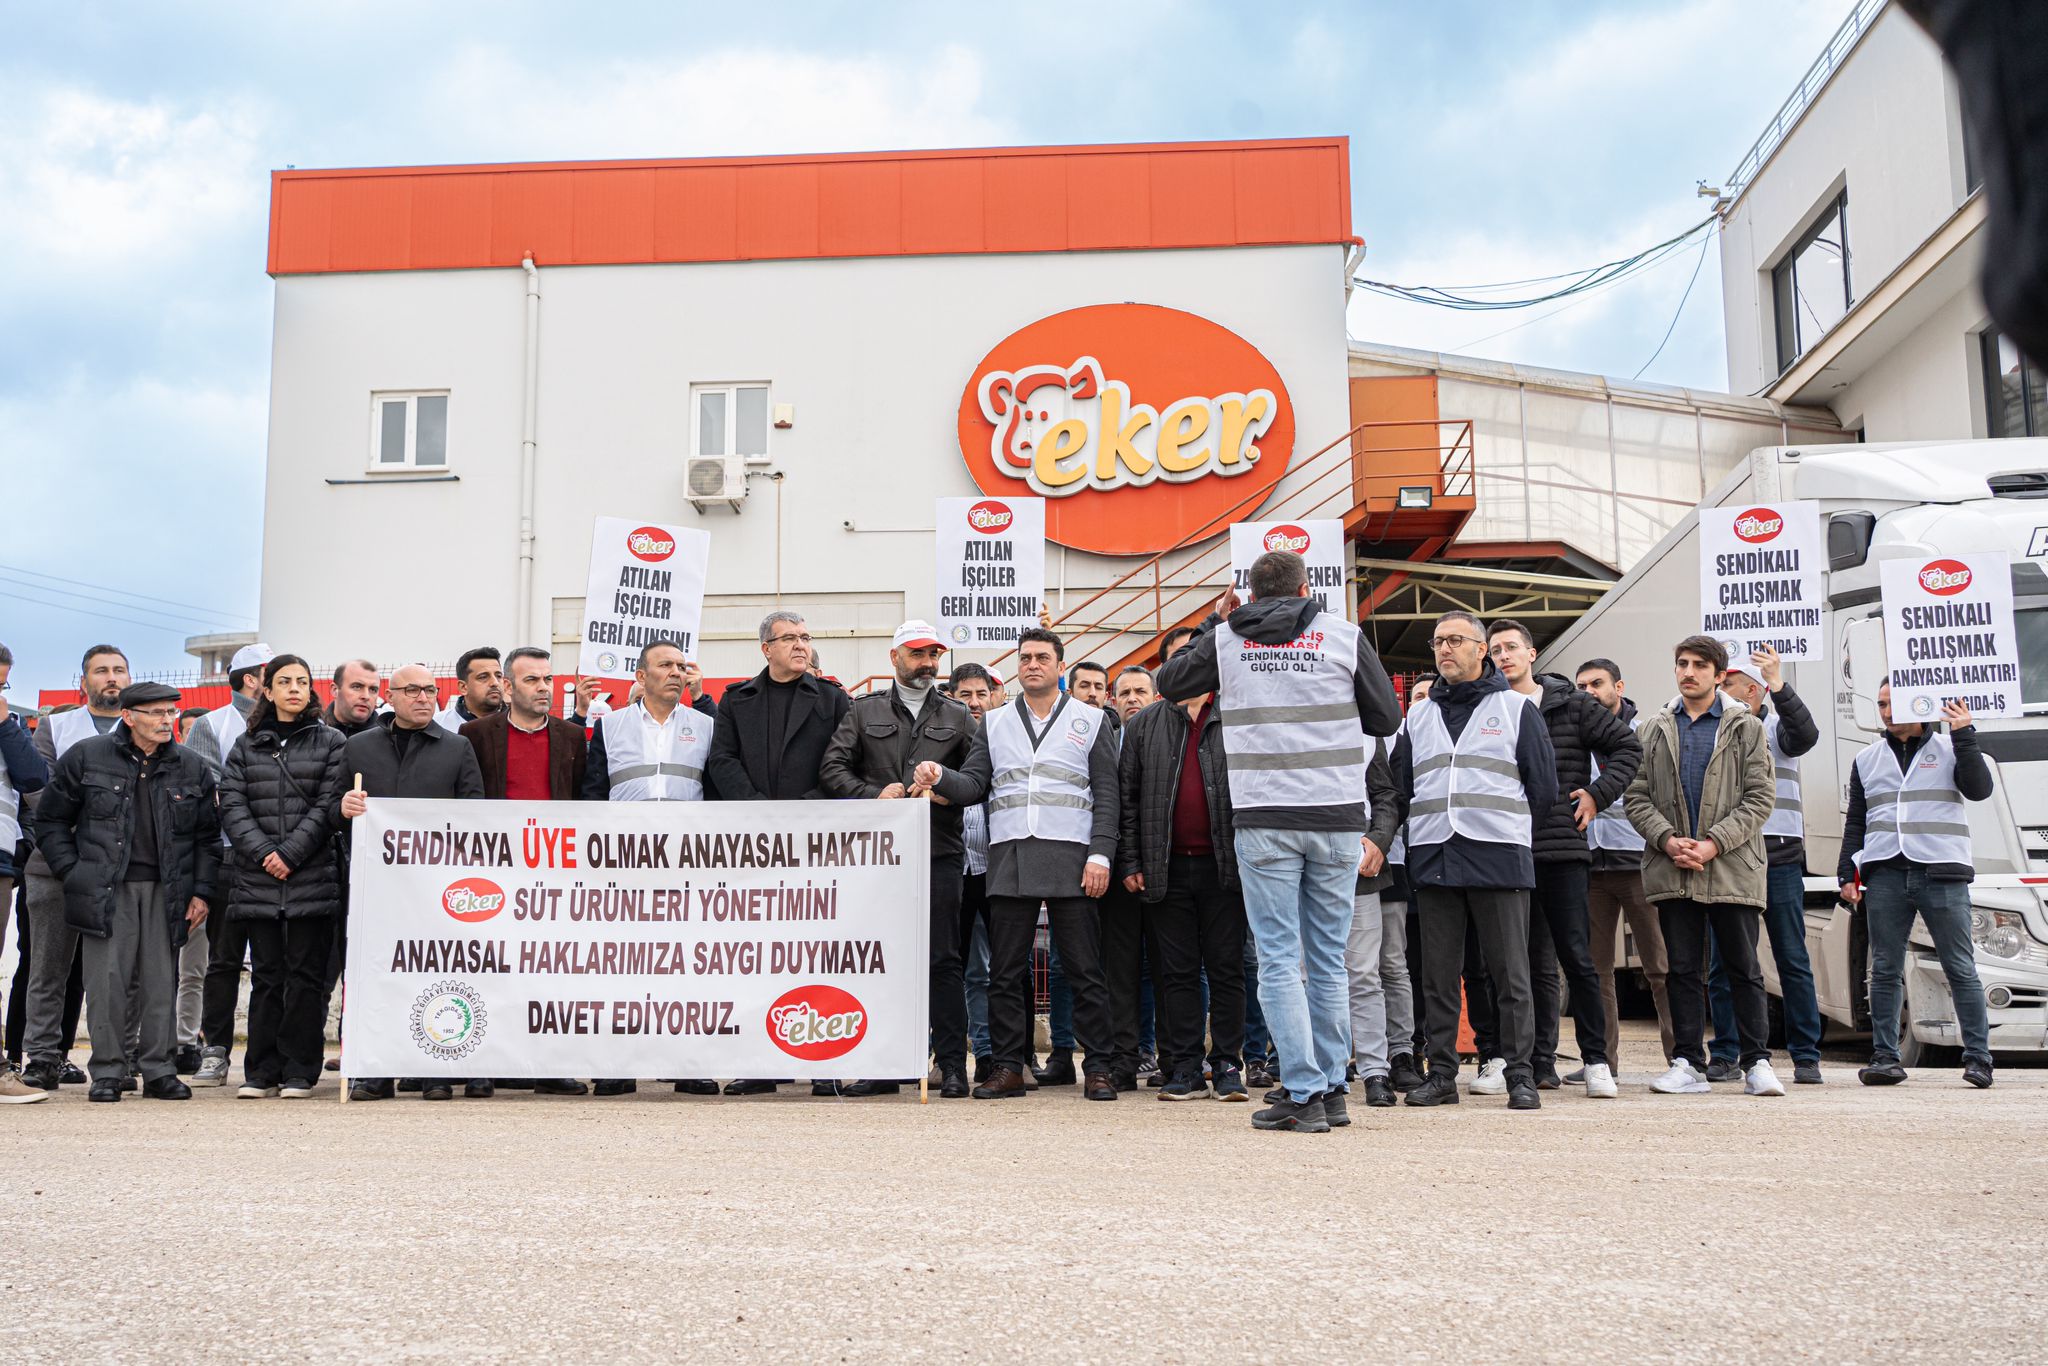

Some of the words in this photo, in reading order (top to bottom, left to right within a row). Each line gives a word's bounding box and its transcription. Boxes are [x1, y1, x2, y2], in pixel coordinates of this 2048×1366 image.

[1034, 387, 1268, 487] eker
[978, 512, 1011, 527] eker
[1744, 519, 1781, 536] eker
[637, 538, 673, 553] eker
[964, 540, 1013, 561] ATILAN
[1274, 536, 1307, 551] eker
[1716, 548, 1799, 576] SENDİKALI
[619, 566, 672, 592] ATILAN
[962, 563, 1016, 591] İŞÇİLER
[1930, 570, 1969, 589] eker
[614, 589, 672, 620] İŞÇİLER
[941, 593, 973, 617] GERİ
[976, 596, 1037, 617] ALINSIN!
[1719, 579, 1802, 610] ÇALIŞMAK
[1704, 611, 1764, 631] ANAYASAL
[1768, 608, 1819, 628] HAKTIR!
[1901, 600, 1992, 630] SENDİKALI
[588, 620, 624, 645] GERİ
[1240, 650, 1299, 661] SENDİKALI
[1303, 652, 1318, 661] OL
[1907, 633, 1997, 665] ÇALIŞMAK
[1250, 661, 1289, 674] GÜÇLÜ
[1292, 663, 1307, 672] OL
[1892, 667, 1958, 687] ANAYASAL
[1962, 663, 2017, 683] HAKTIR!
[1941, 692, 2005, 713] TGIDA-İŞ
[382, 822, 513, 868] SENDİKAYA
[522, 818, 577, 869] ÜYE
[587, 833, 670, 869] OLMAK
[678, 833, 800, 869] ANAYASAL
[807, 831, 901, 868] HAKTIR.
[455, 893, 502, 913] eker
[513, 881, 563, 921] SÜT
[569, 880, 690, 922] ÜRÜNLERİ
[698, 879, 837, 922] YÖNETİMİNİ
[391, 939, 511, 975] ANAYASAL
[519, 940, 686, 975] HAKLARIMIZA
[693, 941, 762, 975] SAYGI
[770, 940, 886, 975] DUYMAYA
[435, 987, 444, 995] VE
[527, 1000, 604, 1035] DAVET
[611, 993, 740, 1035] EDİYORUZ.
[788, 1012, 860, 1043] eker
